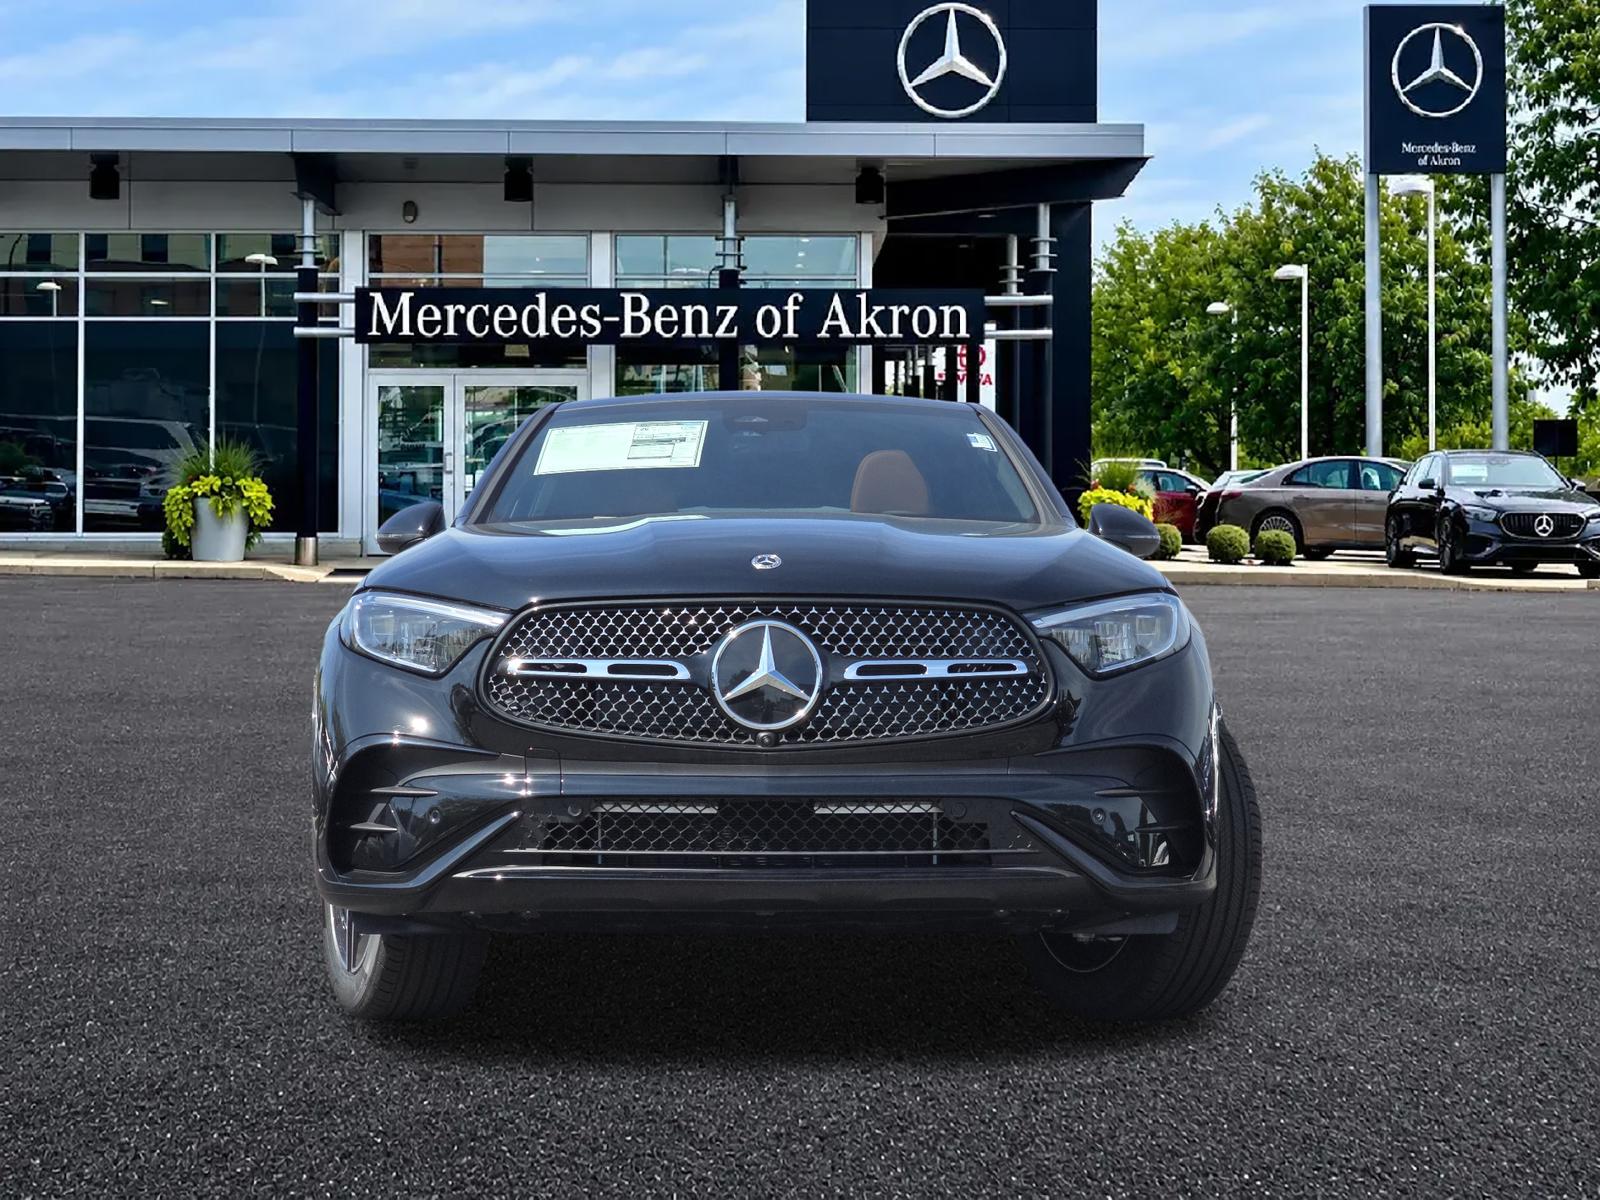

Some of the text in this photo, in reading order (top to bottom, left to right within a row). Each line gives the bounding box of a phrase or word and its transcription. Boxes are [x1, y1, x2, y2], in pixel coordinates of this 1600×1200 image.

[1401, 142, 1476, 153] Mercedes-Benz
[1417, 155, 1461, 166] of Akron
[367, 291, 971, 339] Mercedes-Benz of Akron
